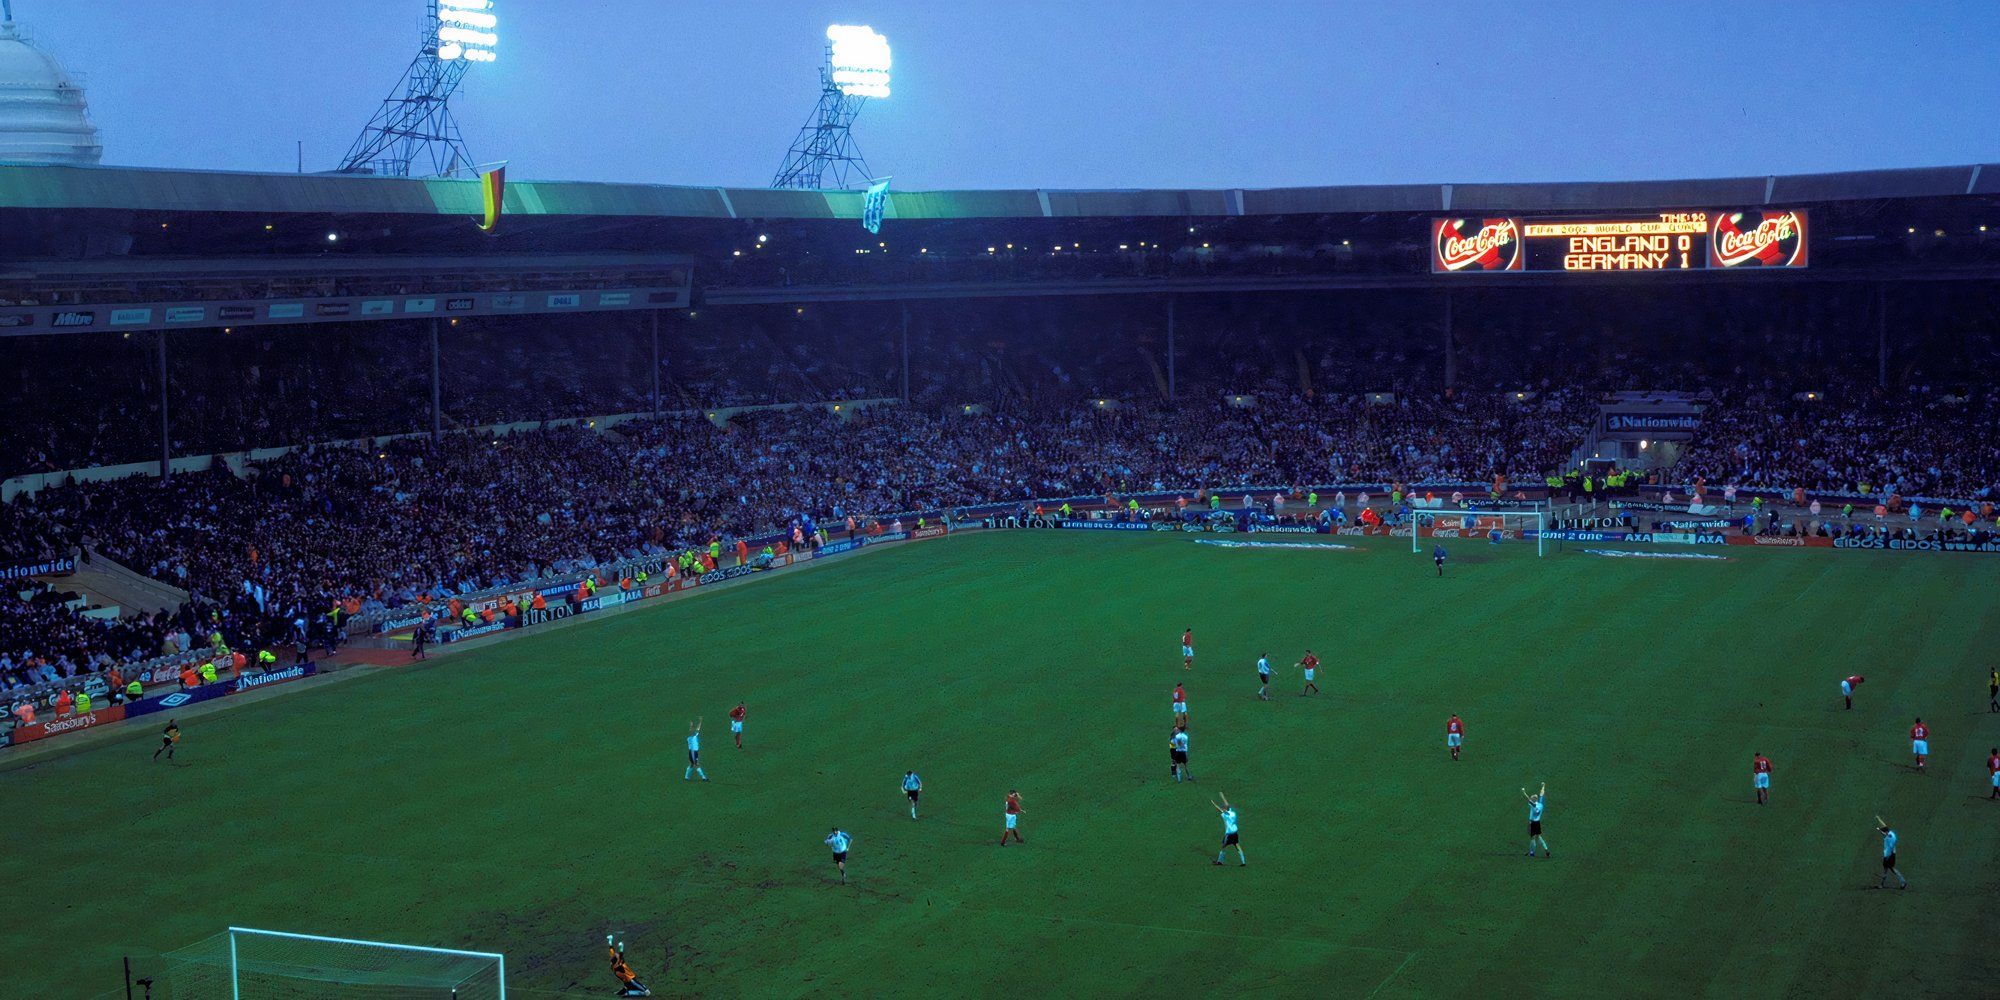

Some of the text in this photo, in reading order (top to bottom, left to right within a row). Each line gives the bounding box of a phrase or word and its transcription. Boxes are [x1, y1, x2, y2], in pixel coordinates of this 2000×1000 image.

[1569, 235, 1691, 253] ENGLAND 0
[1563, 252, 1689, 270] GERMANY 1
[1622, 415, 1701, 428] Nationwide
[1669, 520, 1731, 529] Natiowide
[1625, 533, 1652, 542] AXA
[1697, 535, 1725, 544] AXA
[522, 603, 574, 627] BURTON
[243, 665, 304, 689] Nationwide
[44, 711, 97, 734] Sainsbury's
